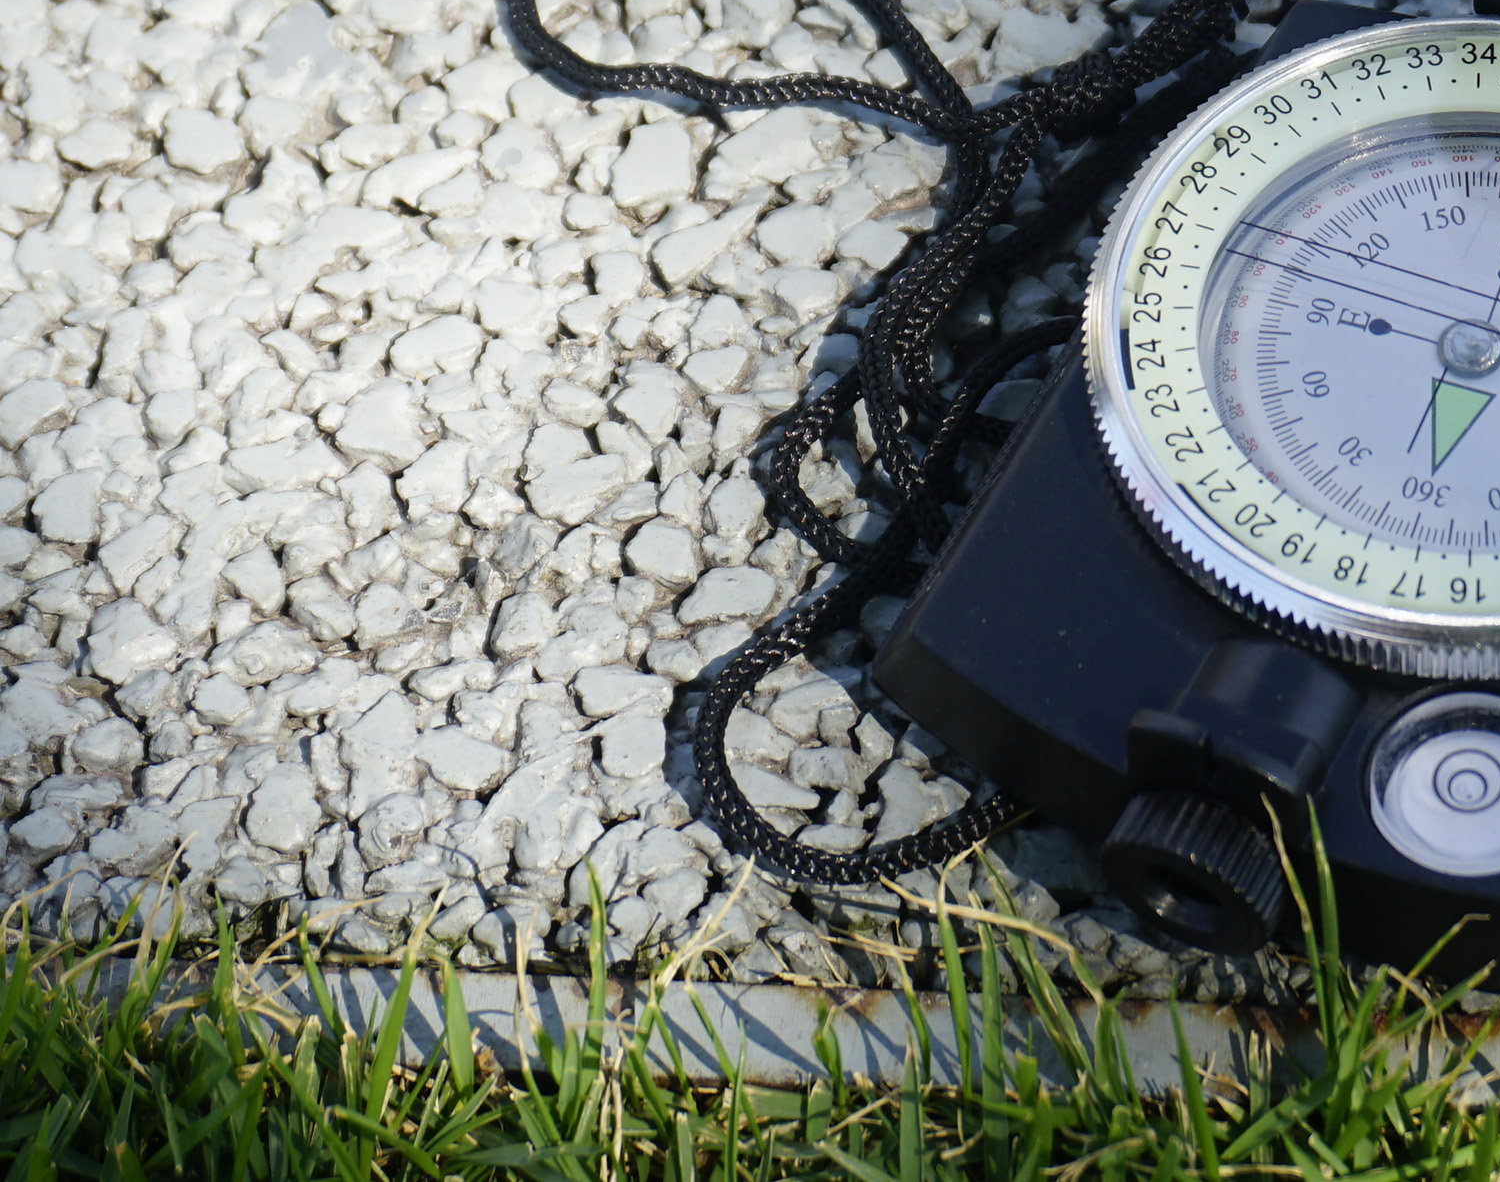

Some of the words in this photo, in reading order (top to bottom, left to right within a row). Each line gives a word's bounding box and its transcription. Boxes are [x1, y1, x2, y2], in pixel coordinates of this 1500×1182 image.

[1351, 54, 1391, 81] 32
[1405, 44, 1444, 69] 33
[1460, 42, 1498, 65] 34
[1300, 69, 1338, 100] 31
[1253, 94, 1293, 125] 30
[1214, 124, 1251, 158] 29
[1180, 161, 1218, 194] 28
[1155, 200, 1189, 235] 27
[1421, 204, 1467, 233] 150
[1139, 246, 1172, 278] 26
[1346, 231, 1391, 270] 120
[1133, 292, 1163, 323] 25
[1306, 297, 1337, 326] 90
[1336, 306, 1372, 331] E
[1135, 337, 1166, 372] 24
[1301, 369, 1331, 399] 60
[1144, 382, 1181, 418] 23
[1164, 425, 1205, 463] 22
[1337, 435, 1374, 467] 30
[1196, 468, 1237, 503] 21
[1402, 475, 1452, 508] 360
[1234, 502, 1277, 538] 20
[1280, 534, 1318, 565] 19
[1333, 555, 1369, 587] 18
[1389, 571, 1426, 599] 17
[1450, 577, 1486, 604] 16
